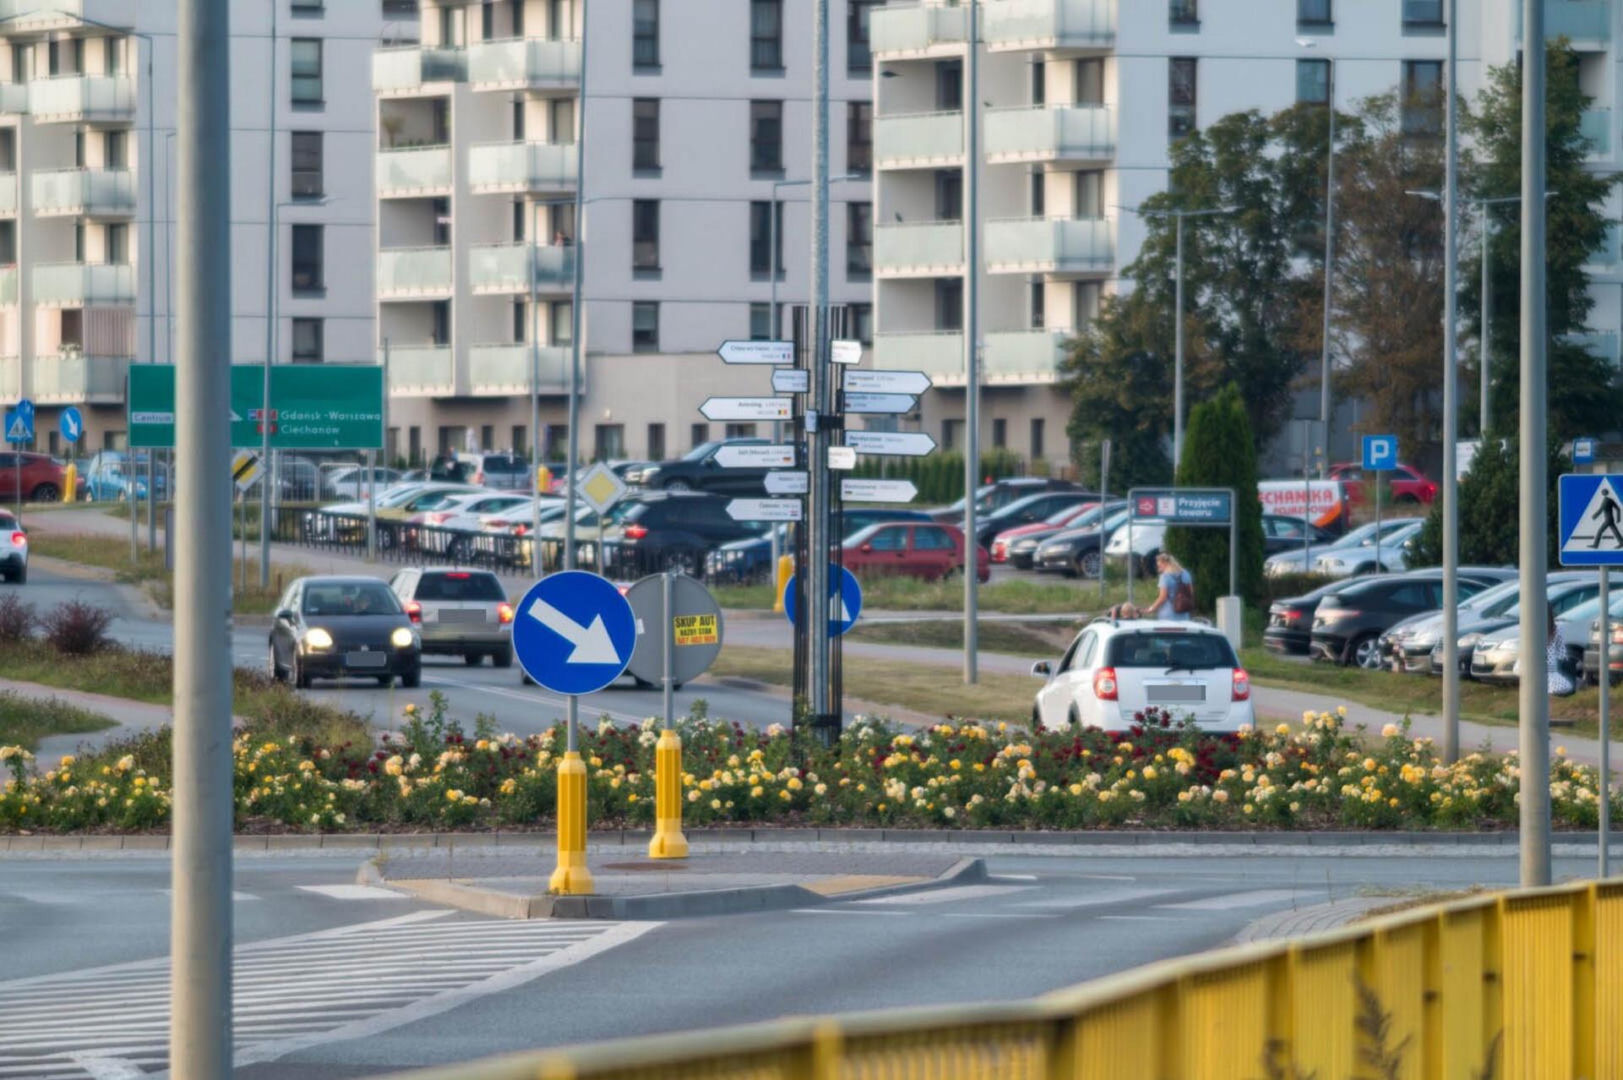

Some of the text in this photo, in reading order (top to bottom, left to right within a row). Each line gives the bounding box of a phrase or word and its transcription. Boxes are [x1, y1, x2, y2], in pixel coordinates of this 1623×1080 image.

[1371, 440, 1389, 465] P
[675, 615, 714, 628] SKUP AUT
